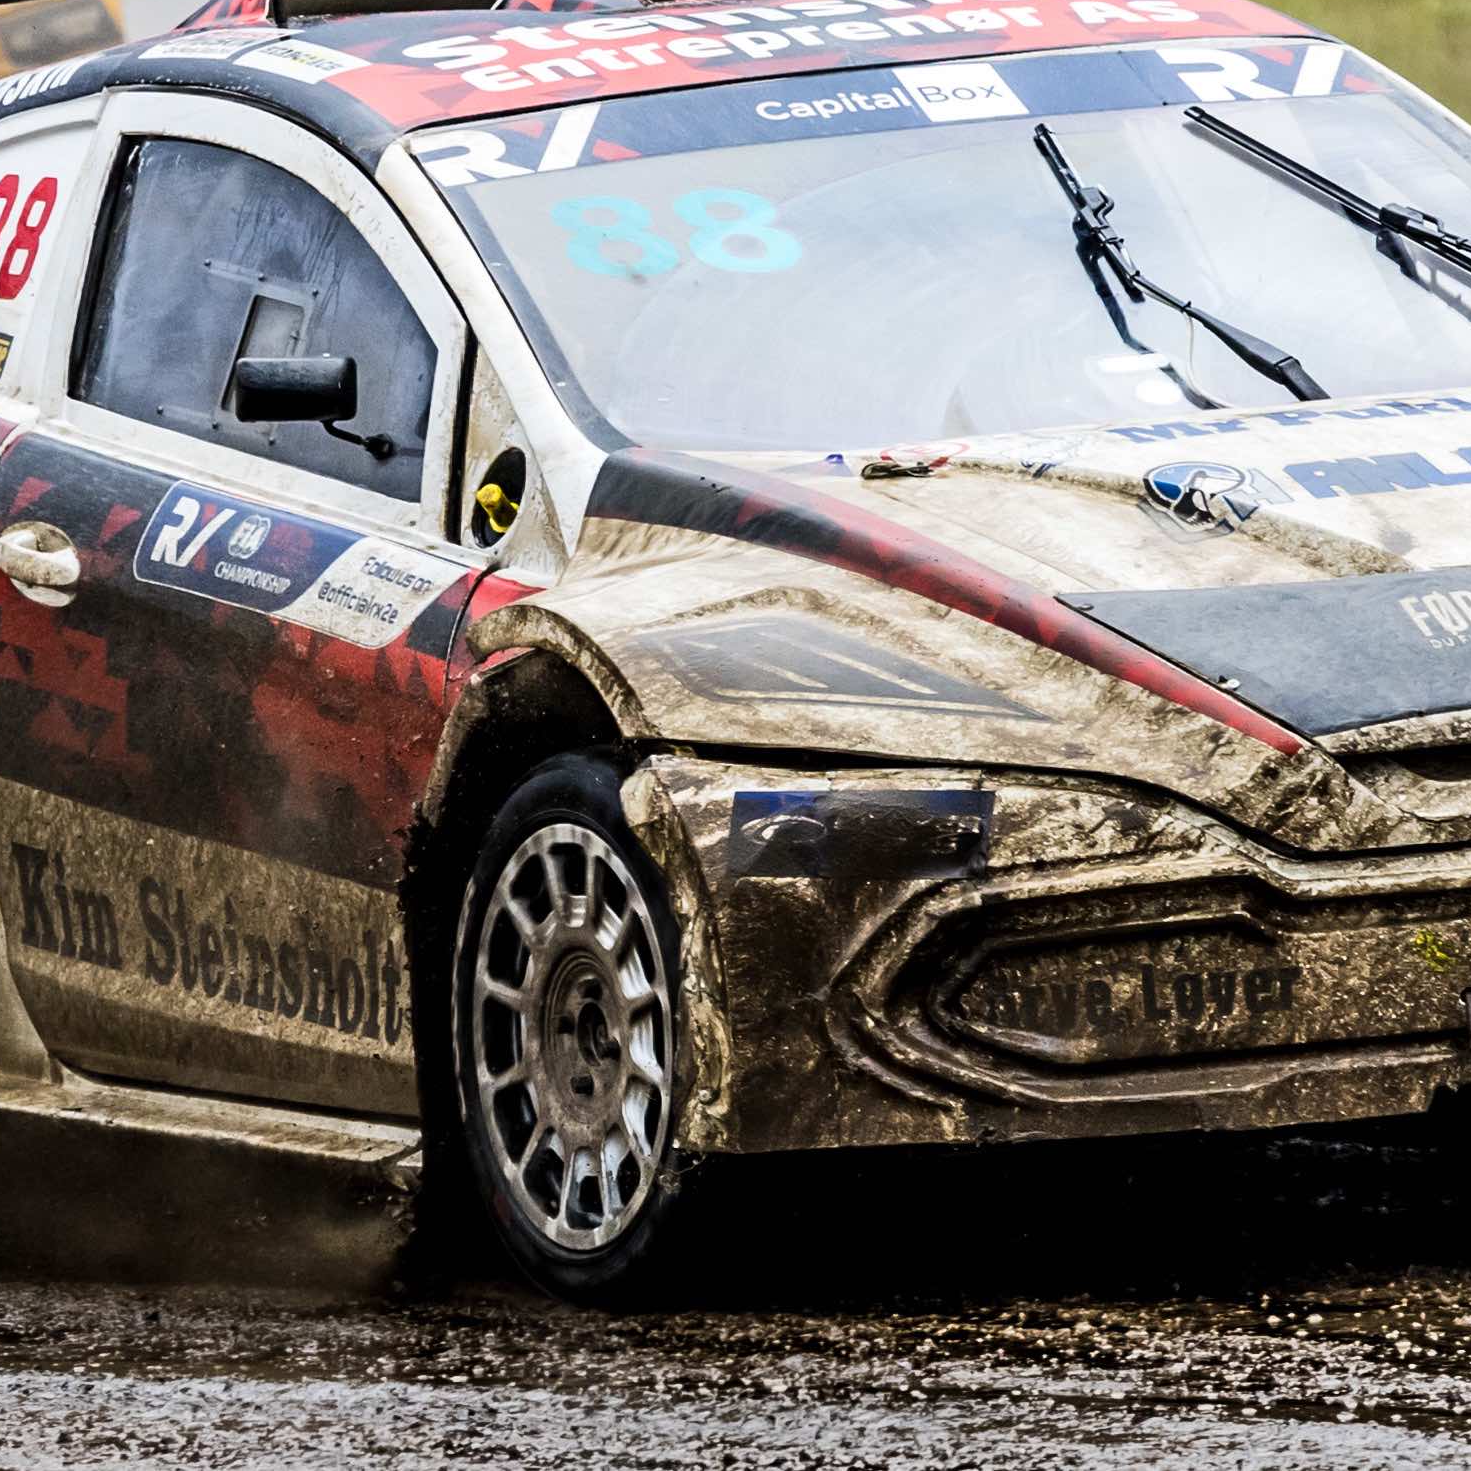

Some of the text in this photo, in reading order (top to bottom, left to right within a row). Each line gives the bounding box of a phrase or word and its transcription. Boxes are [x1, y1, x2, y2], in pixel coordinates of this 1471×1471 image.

[1068, 0, 1201, 25] AS
[549, 187, 803, 276] 88
[214, 560, 292, 595] CHAMPIONSHIP
[1429, 637, 1455, 650] DU
[10, 841, 124, 971] Kim
